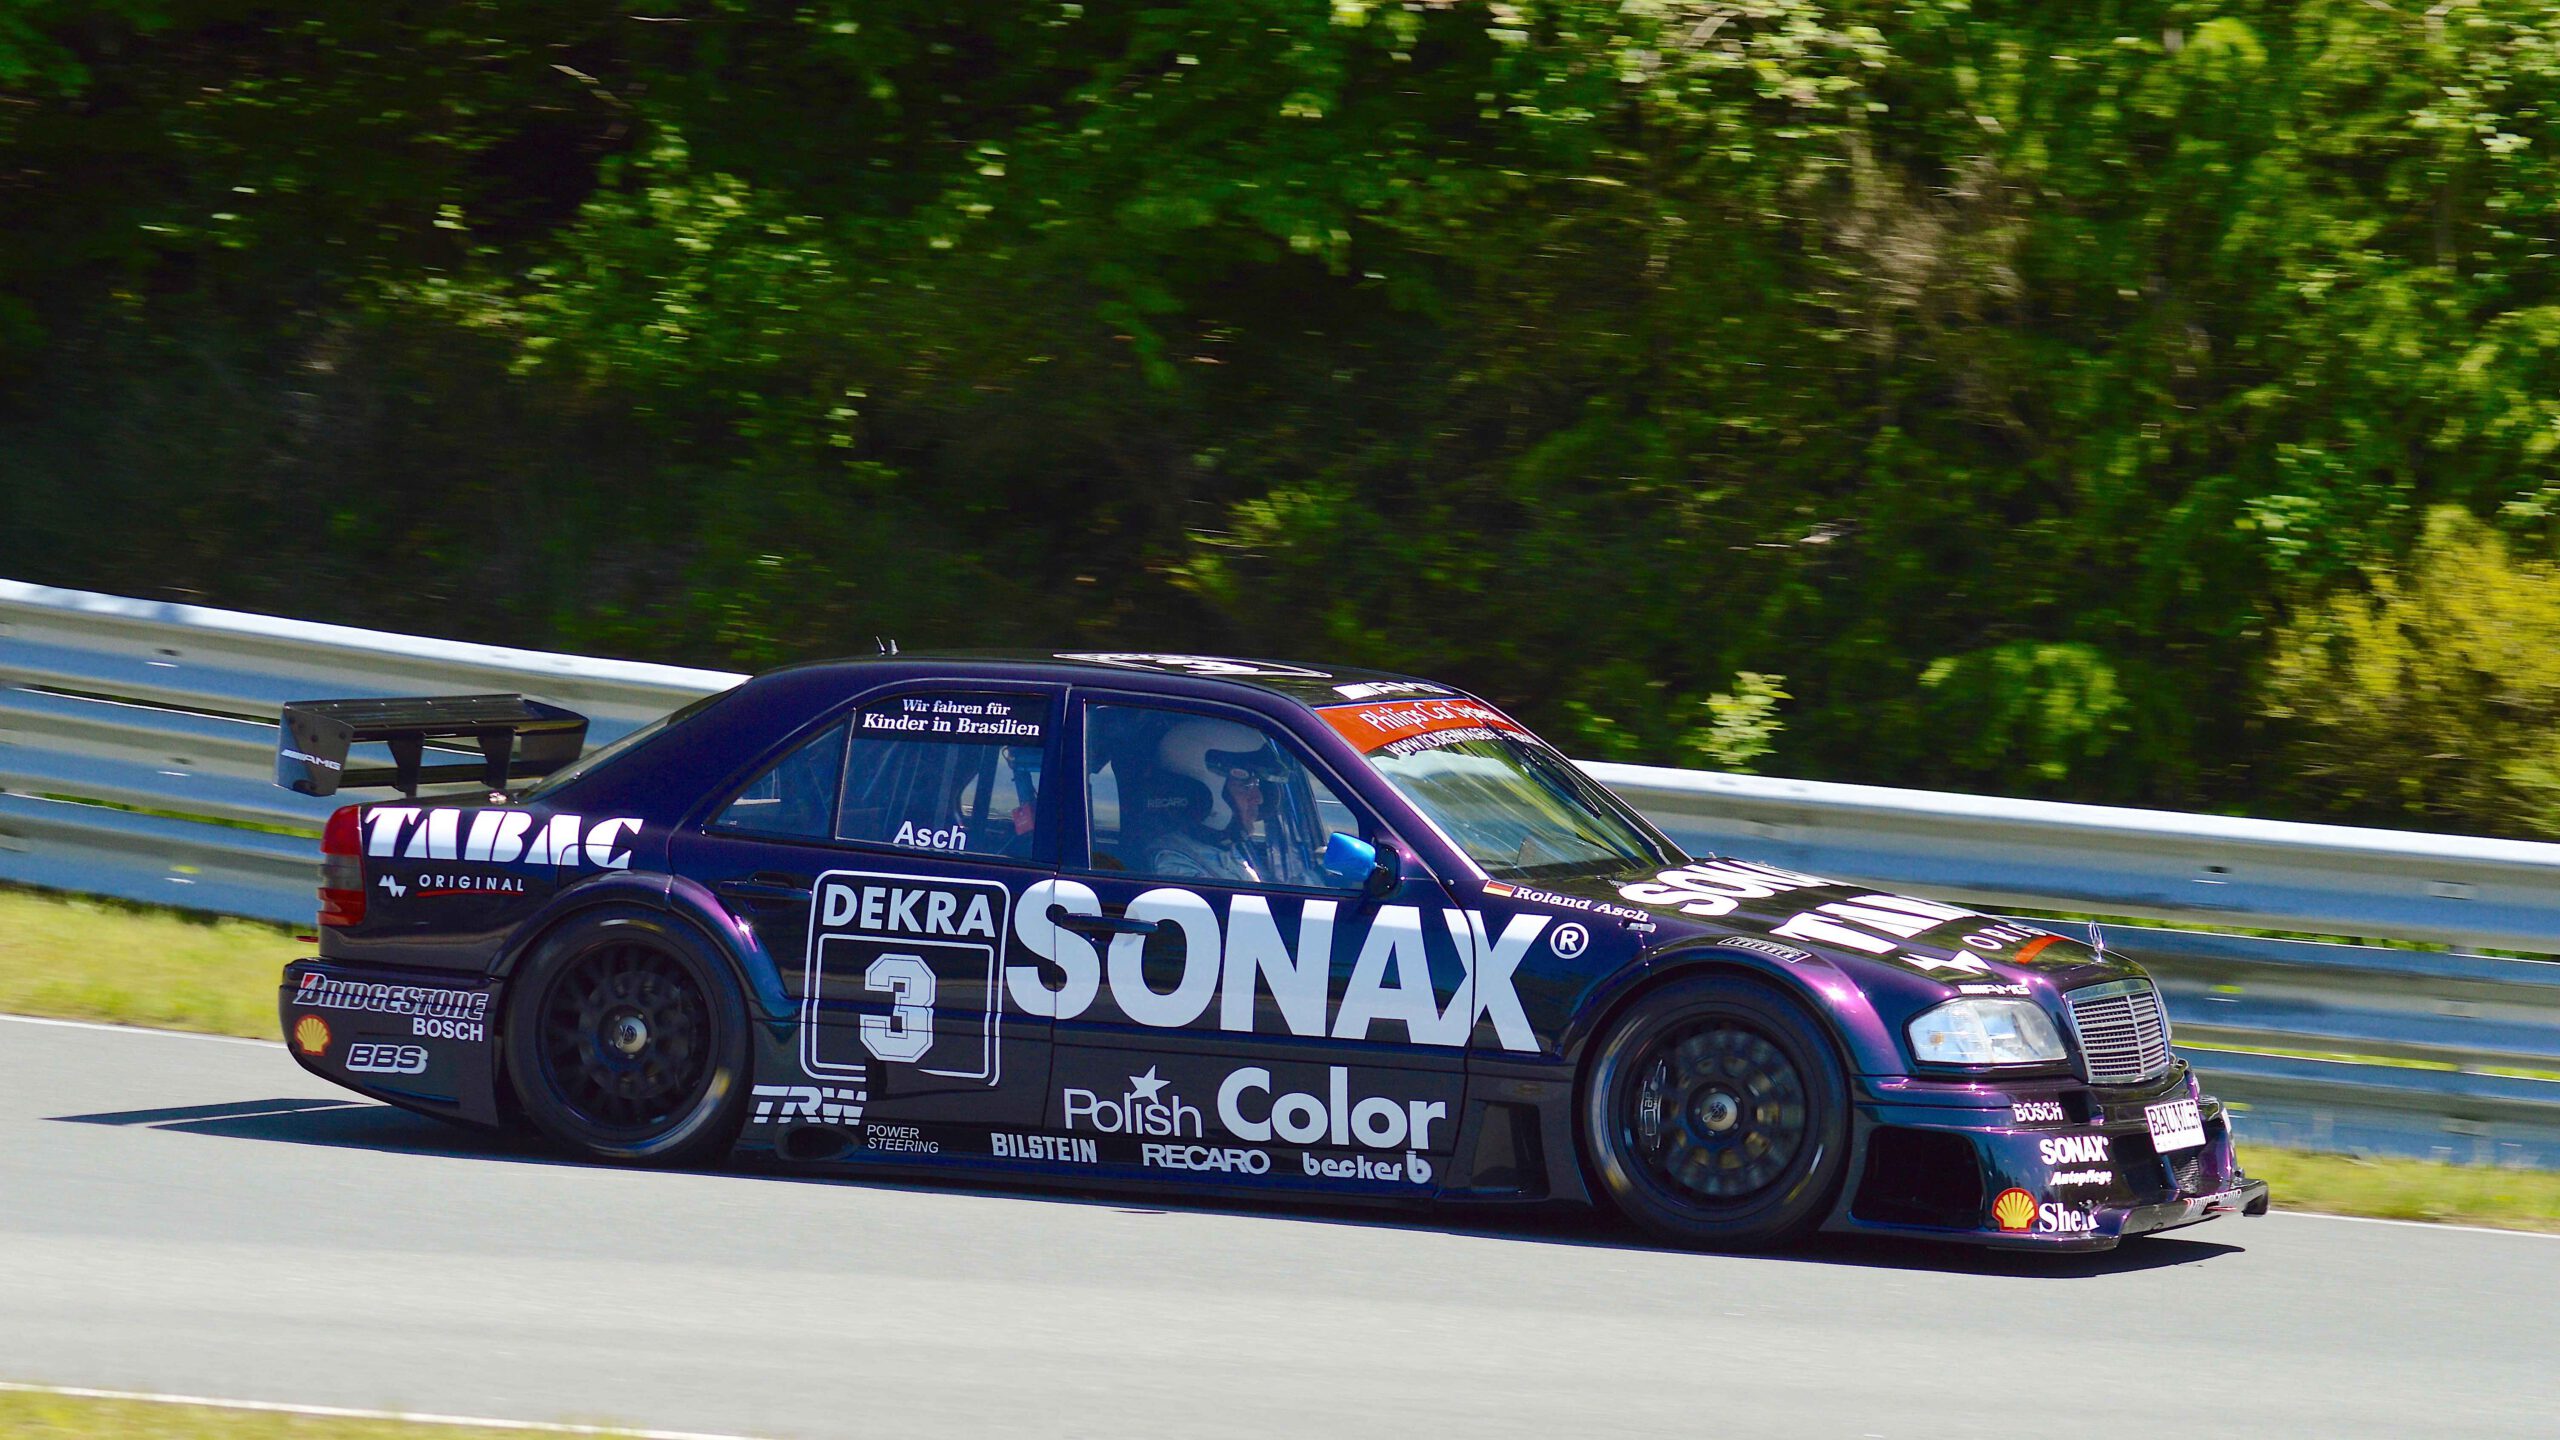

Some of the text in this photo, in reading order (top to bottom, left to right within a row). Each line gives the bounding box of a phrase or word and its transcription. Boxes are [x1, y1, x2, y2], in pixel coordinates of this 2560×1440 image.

[902, 699, 1010, 716] Wir fahren für
[1359, 703, 1429, 733] Philips
[1413, 702, 1456, 720] Car
[863, 713, 1040, 736] Kinder in Brasilien
[364, 807, 644, 869] TABAC
[893, 821, 967, 850] Asch
[419, 874, 525, 892] ORIGINAL
[821, 884, 996, 938] DEKRA
[1514, 886, 1650, 923] Roland Asch
[1005, 878, 1553, 1054] SONAX
[293, 973, 489, 1020] BRIDGESTONE
[858, 953, 936, 1064] 3
[412, 1017, 484, 1042] BOSCH
[346, 1043, 429, 1074] BBS
[752, 1084, 868, 1126] TRW
[1063, 1066, 1446, 1150] Polish Color
[2012, 1102, 2064, 1122] BOSCH
[867, 1125, 920, 1139] POWER
[867, 1138, 940, 1154] STEERING
[990, 1132, 1098, 1163] BILSTEIN
[1142, 1142, 1271, 1175] RECARO
[2039, 1135, 2109, 1165] SONAX
[1302, 1151, 1402, 1181] becker
[2050, 1169, 2113, 1187] Autopflege
